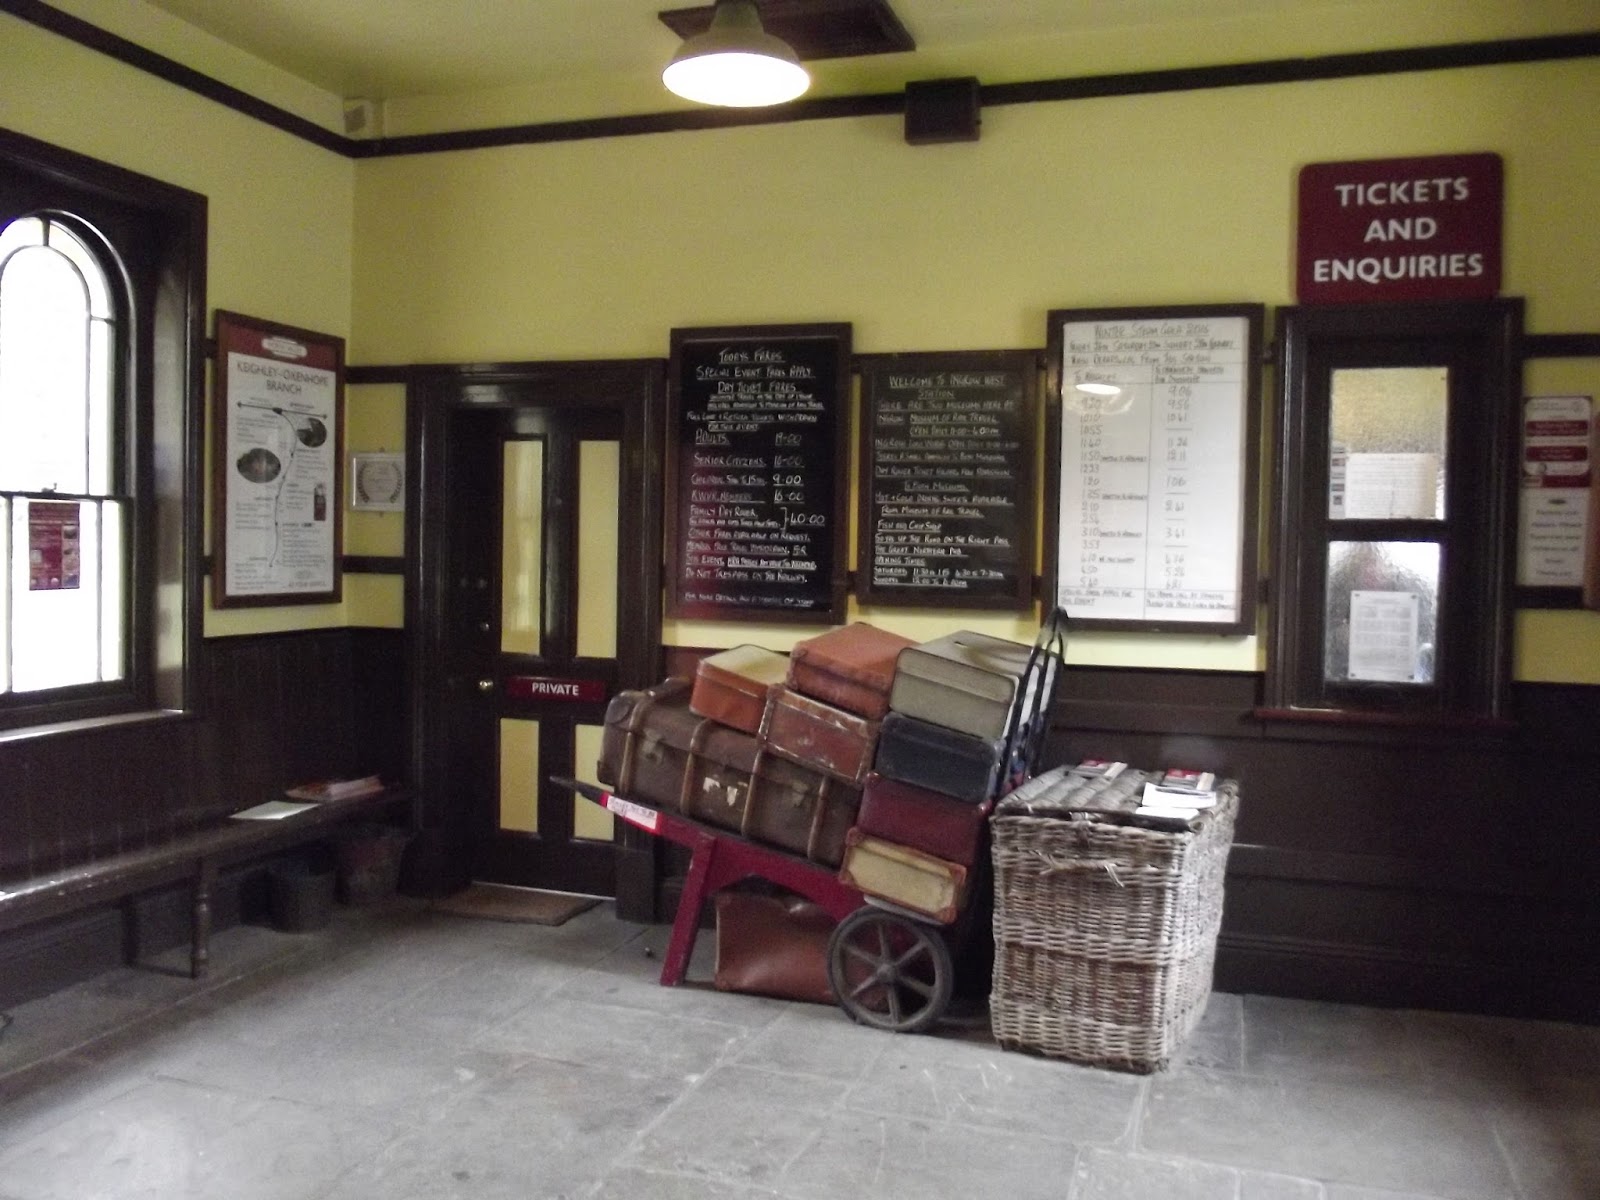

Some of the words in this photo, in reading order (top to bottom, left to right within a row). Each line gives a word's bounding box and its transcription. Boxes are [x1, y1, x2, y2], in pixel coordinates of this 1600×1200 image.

[1334, 177, 1470, 207] TICKETS
[1363, 217, 1437, 243] AND
[1313, 253, 1484, 284] ENQUIRIES
[734, 366, 760, 377] EVENT
[266, 380, 302, 394] BRANCH
[718, 381, 734, 393] DAY
[889, 375, 933, 388] WELCOME
[918, 388, 955, 399] STATION
[878, 519, 893, 529] FISH
[531, 682, 579, 696] PRIVATE
